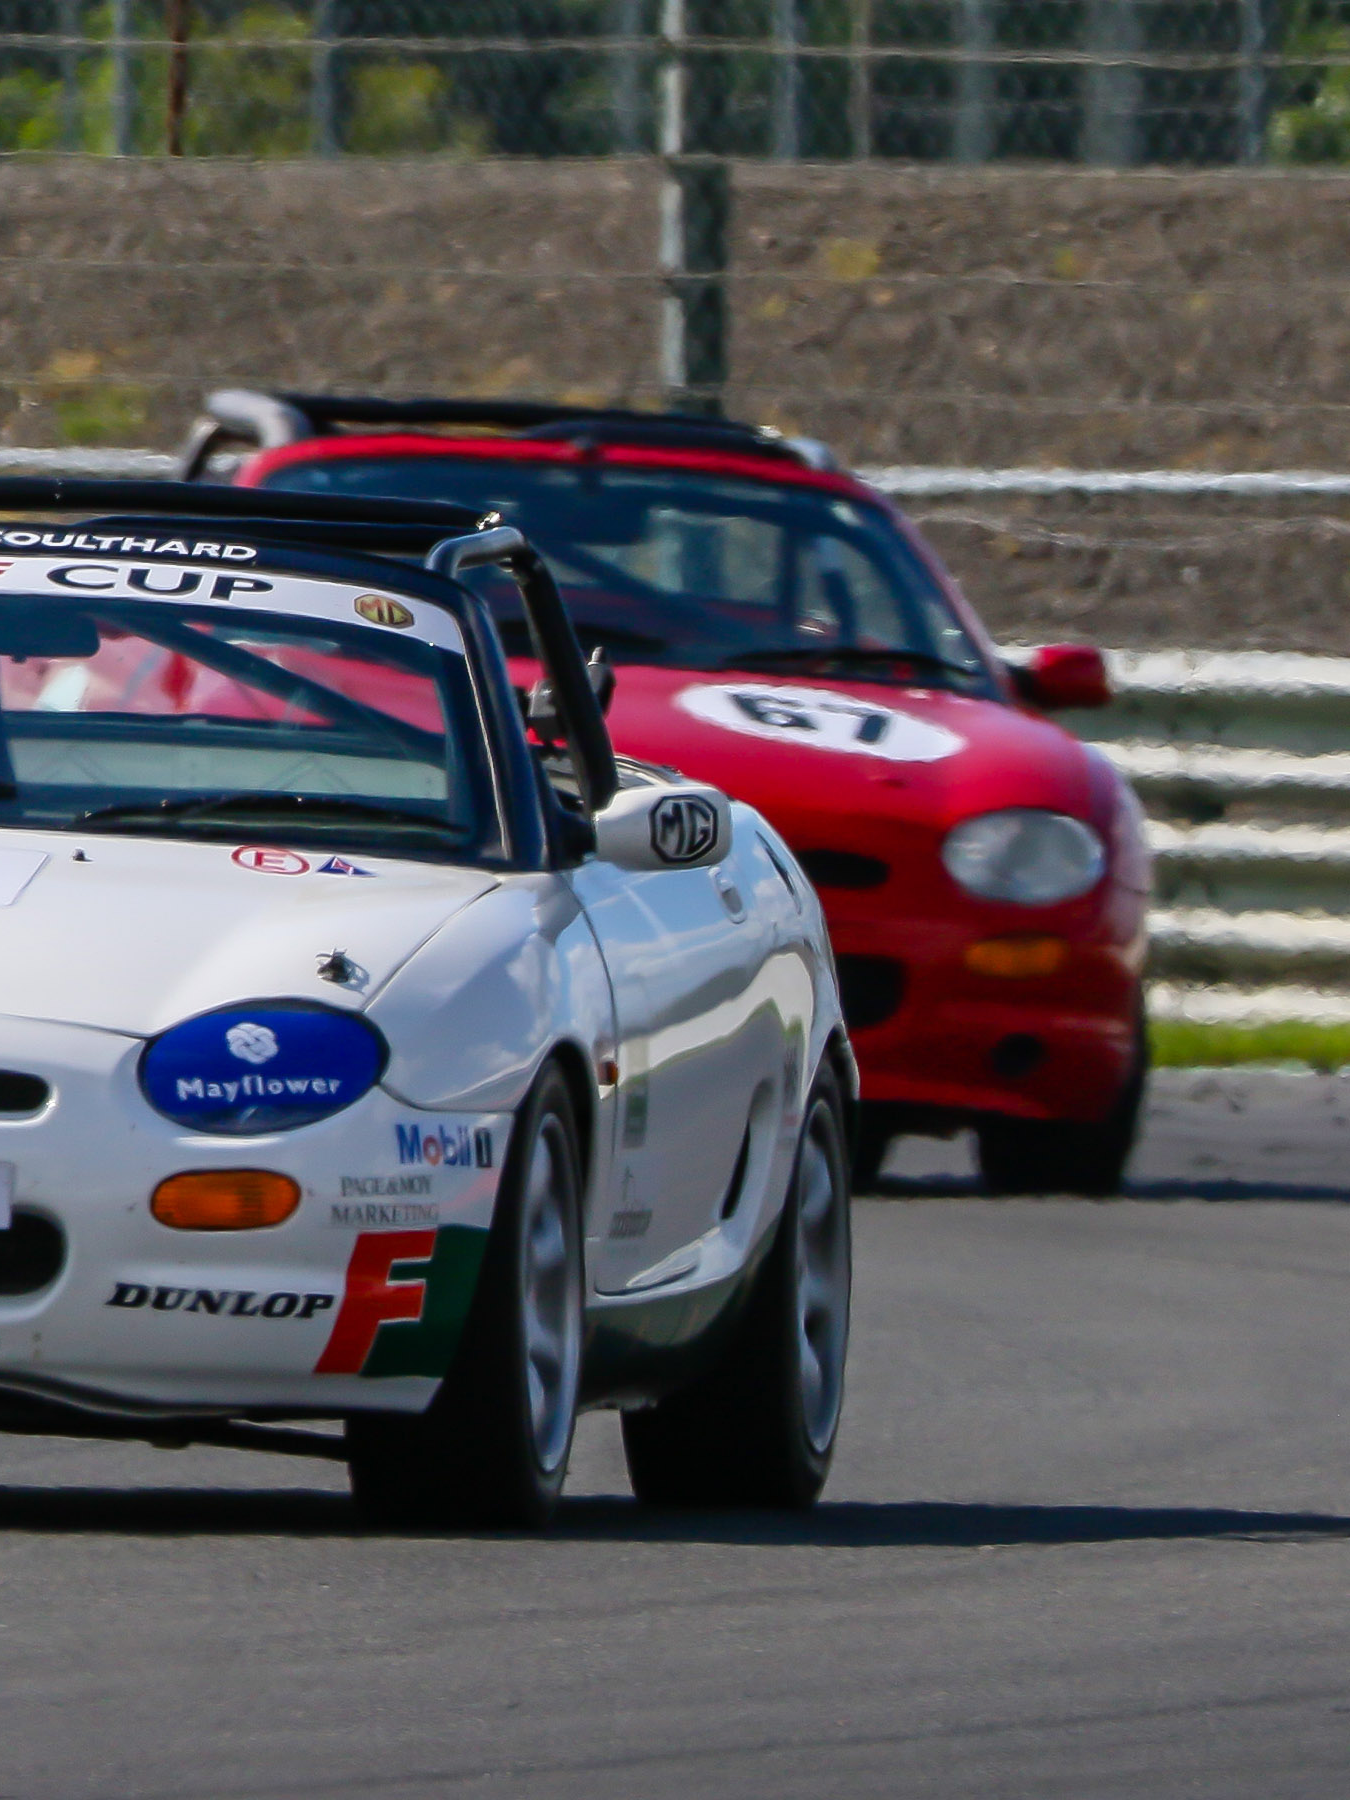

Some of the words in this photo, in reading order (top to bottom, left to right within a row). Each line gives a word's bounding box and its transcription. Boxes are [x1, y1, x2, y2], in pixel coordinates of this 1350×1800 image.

[47, 563, 276, 602] CUP
[724, 690, 890, 744] 67
[653, 798, 714, 859] MG
[176, 1073, 342, 1103] Mayflower
[395, 1123, 471, 1167] Mobil
[105, 1281, 335, 1320] DUNLOP
[312, 1229, 438, 1375] F
